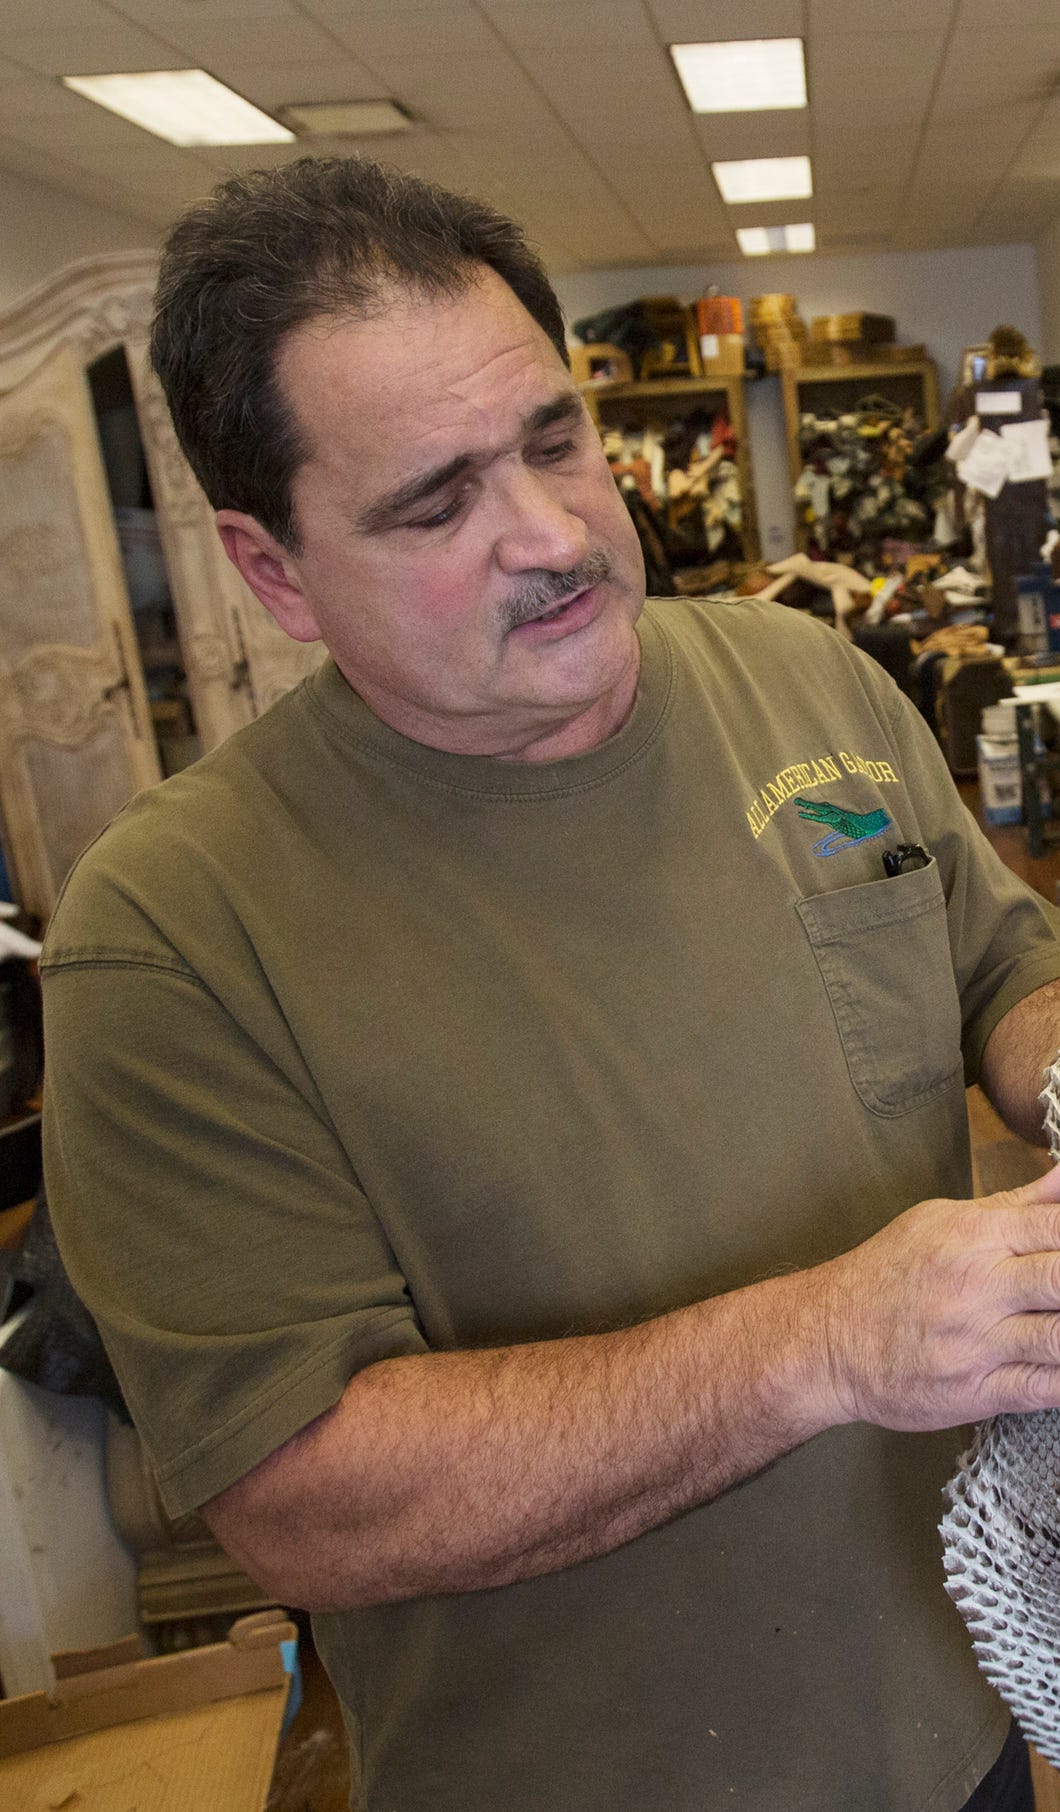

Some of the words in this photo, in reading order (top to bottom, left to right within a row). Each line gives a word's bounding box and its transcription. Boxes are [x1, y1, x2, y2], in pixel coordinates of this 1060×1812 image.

[746, 800, 770, 838] ALL
[760, 756, 842, 816] AMERICAN
[840, 752, 899, 782] GAOR
